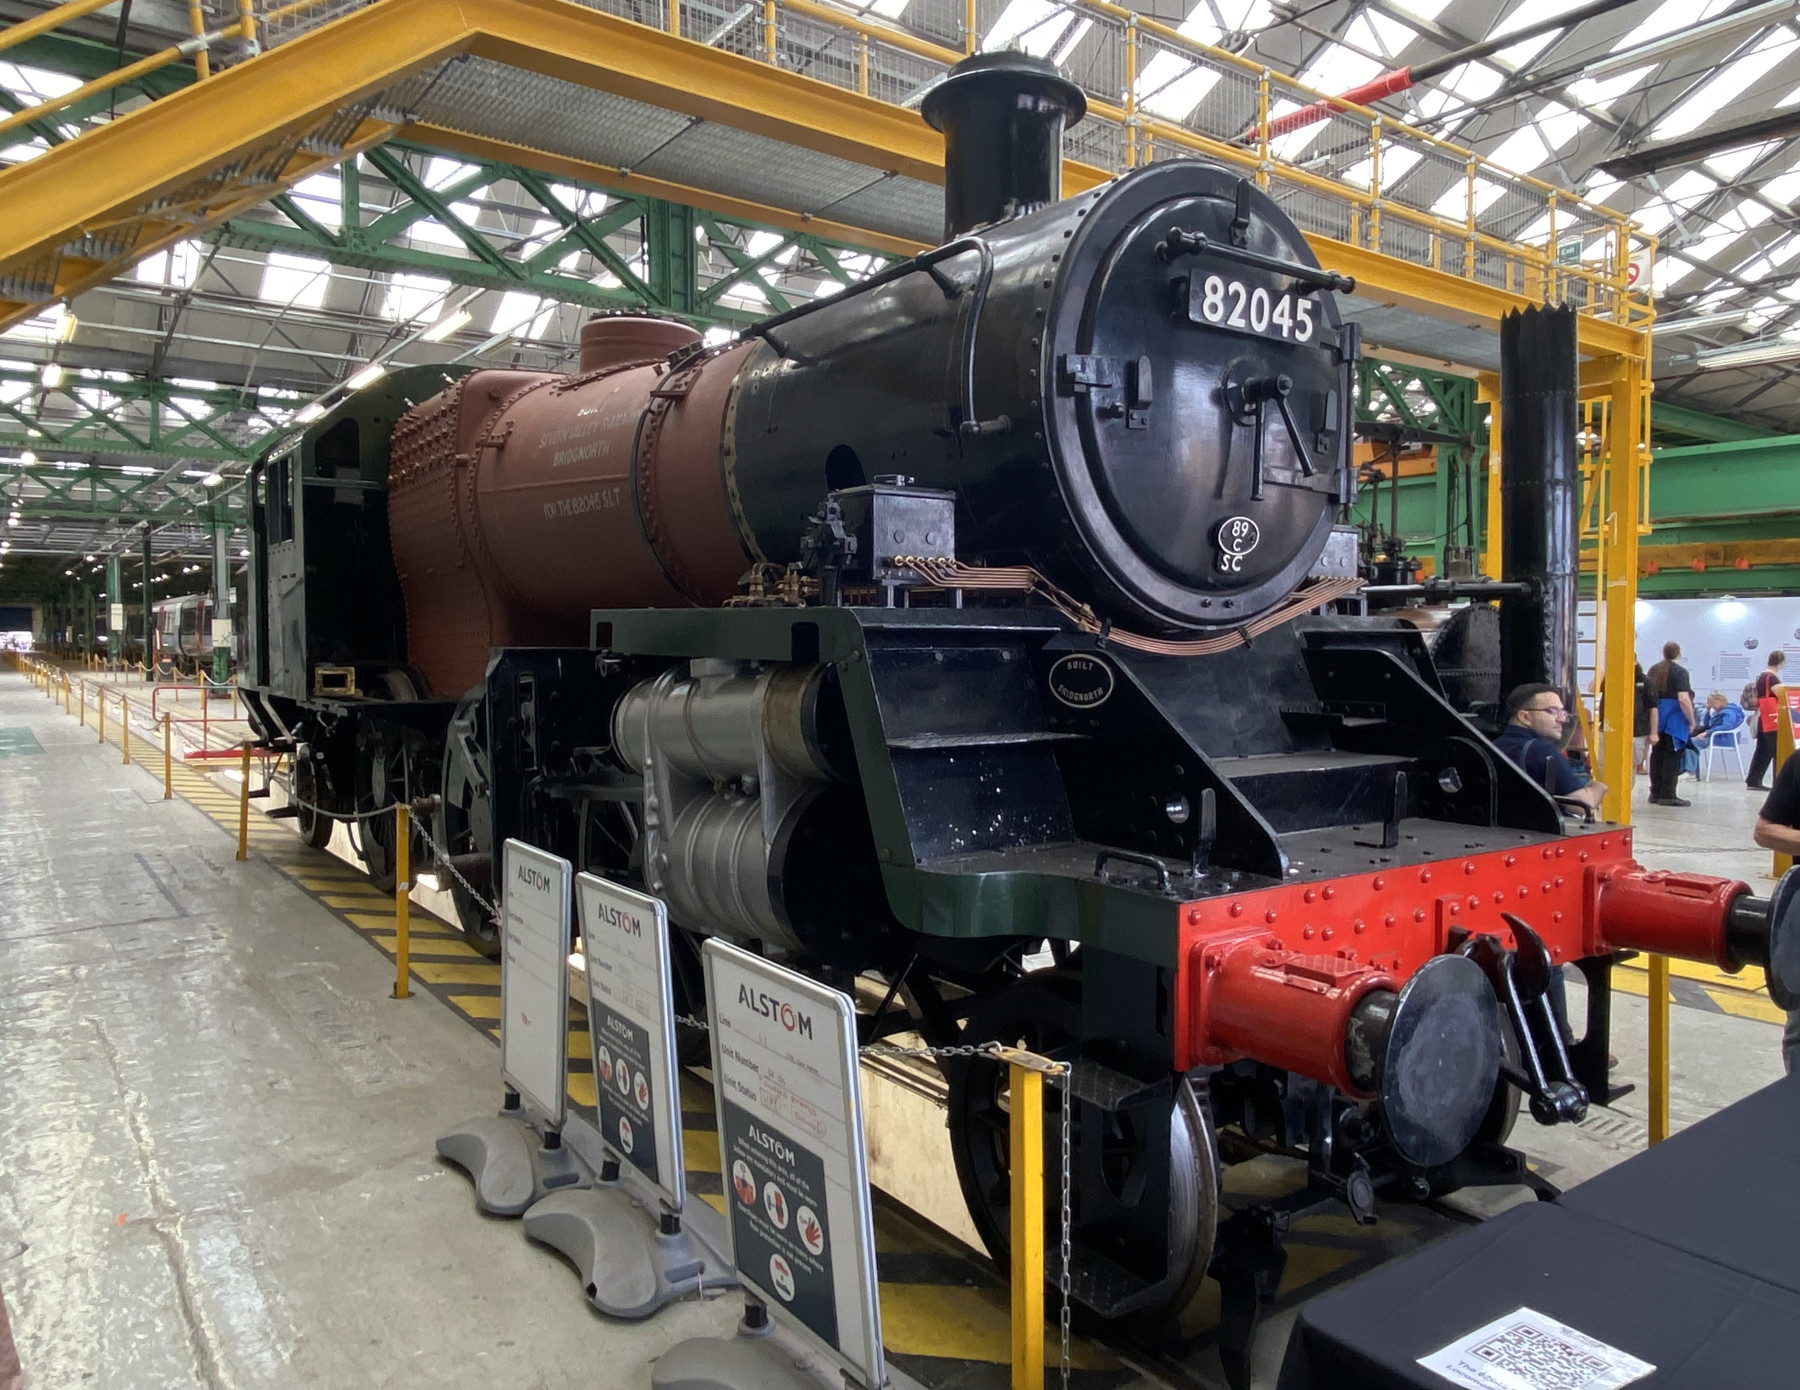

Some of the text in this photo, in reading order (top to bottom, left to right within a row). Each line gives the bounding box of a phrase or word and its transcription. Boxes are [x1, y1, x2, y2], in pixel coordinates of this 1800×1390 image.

[1203, 275, 1313, 342] 82045
[553, 439, 611, 467] BRIDGNORTH
[557, 498, 573, 516] THE
[1232, 520, 1249, 537] 89
[1233, 538, 1243, 551] C
[1221, 554, 1243, 572] SC
[1067, 661, 1093, 671] BUILT
[1058, 683, 1104, 702] BRIDGNORTH
[518, 865, 550, 894] ALSTOM
[598, 902, 641, 938] ALSTOM
[738, 983, 813, 1041] ALSTOM
[607, 1014, 634, 1043] ALSTOM
[721, 1043, 759, 1073] Unit Number
[724, 1072, 737, 1089] Unit
[738, 1080, 757, 1102] Status
[749, 1124, 795, 1167] ALSTOM
[1458, 1360, 1476, 1373] The
